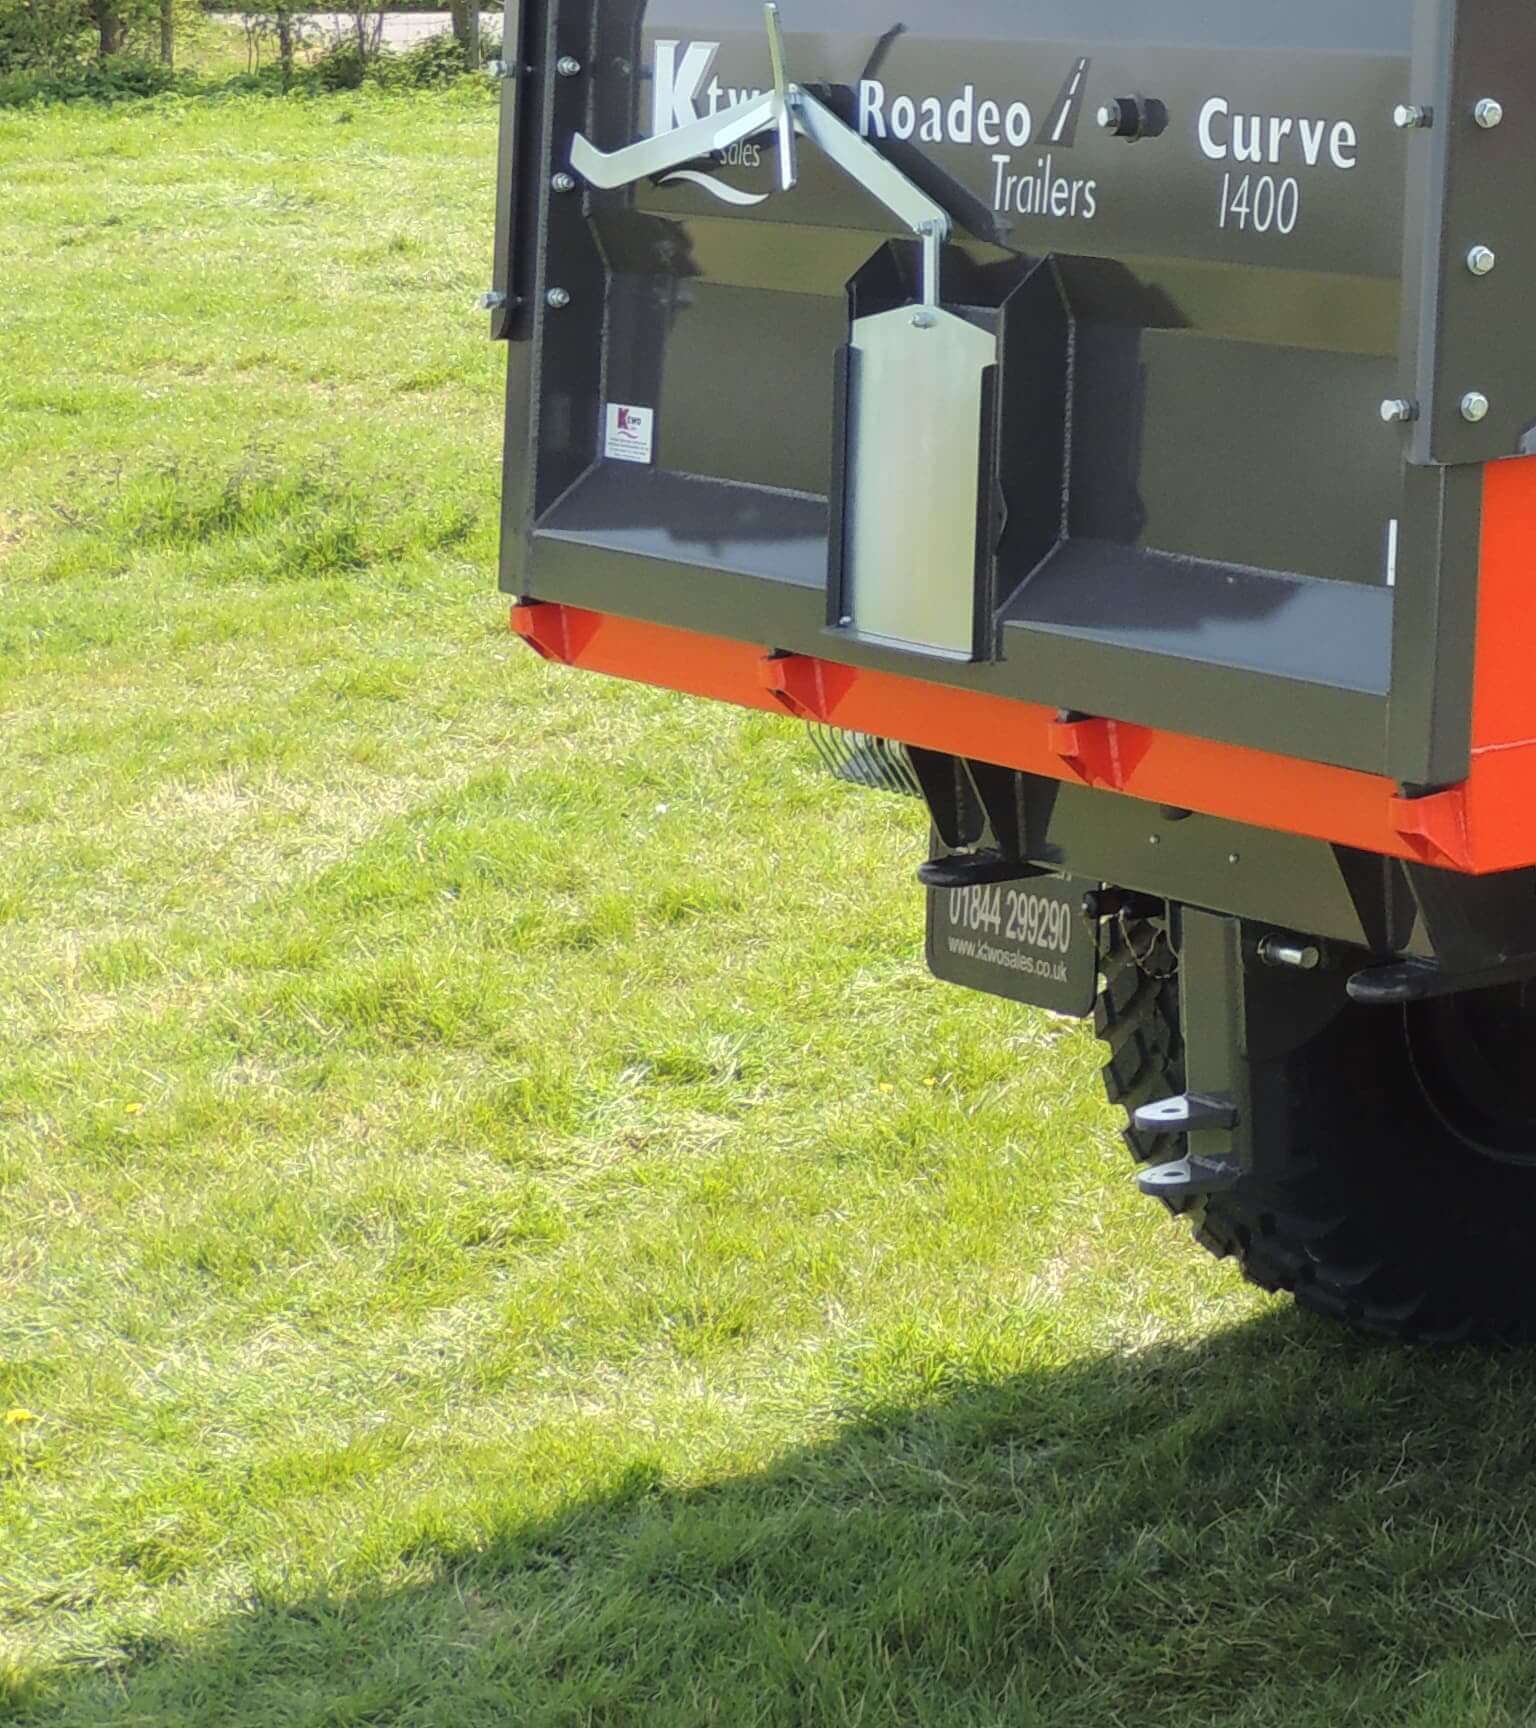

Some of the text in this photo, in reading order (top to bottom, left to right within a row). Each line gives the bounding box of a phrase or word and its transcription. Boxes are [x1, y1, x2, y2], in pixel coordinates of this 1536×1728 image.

[653, 39, 1357, 169] Kt Roadeo Curve
[719, 138, 761, 168] sales
[991, 153, 1299, 234] Trailers 1400
[949, 884, 1072, 954] 01844 299290
[948, 936, 1068, 983] www.ktwosales.co.uk
